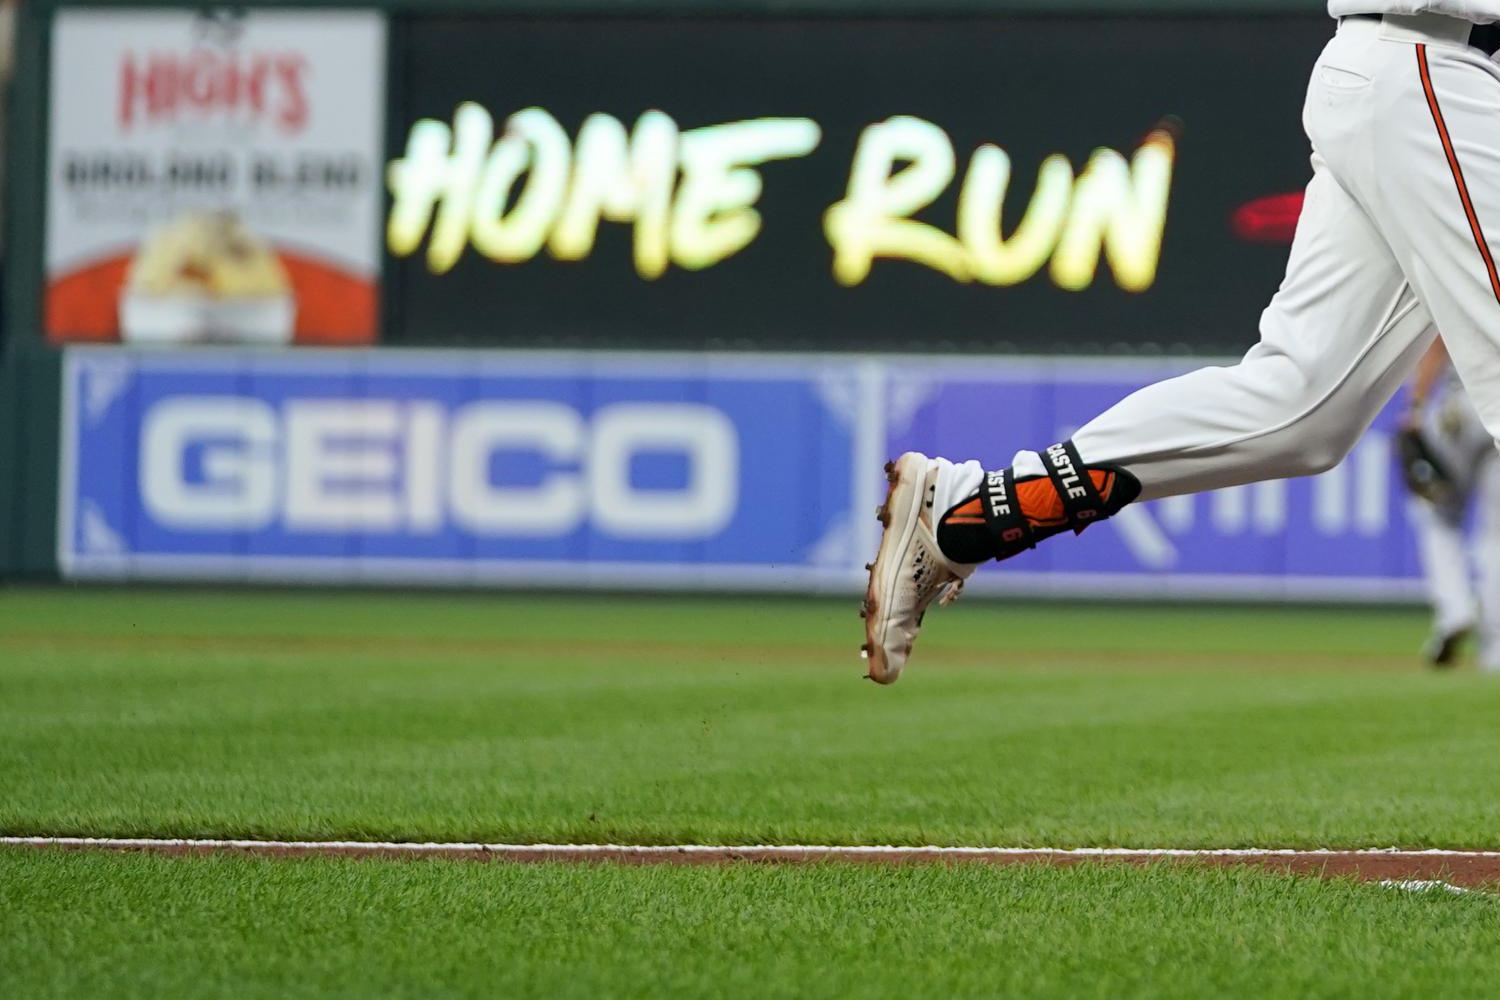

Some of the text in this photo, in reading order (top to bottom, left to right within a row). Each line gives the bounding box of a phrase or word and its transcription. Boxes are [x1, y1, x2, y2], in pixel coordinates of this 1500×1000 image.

[117, 51, 309, 136] HIGH'S
[387, 101, 1180, 291] HOME RUN
[138, 396, 739, 540] GEICO
